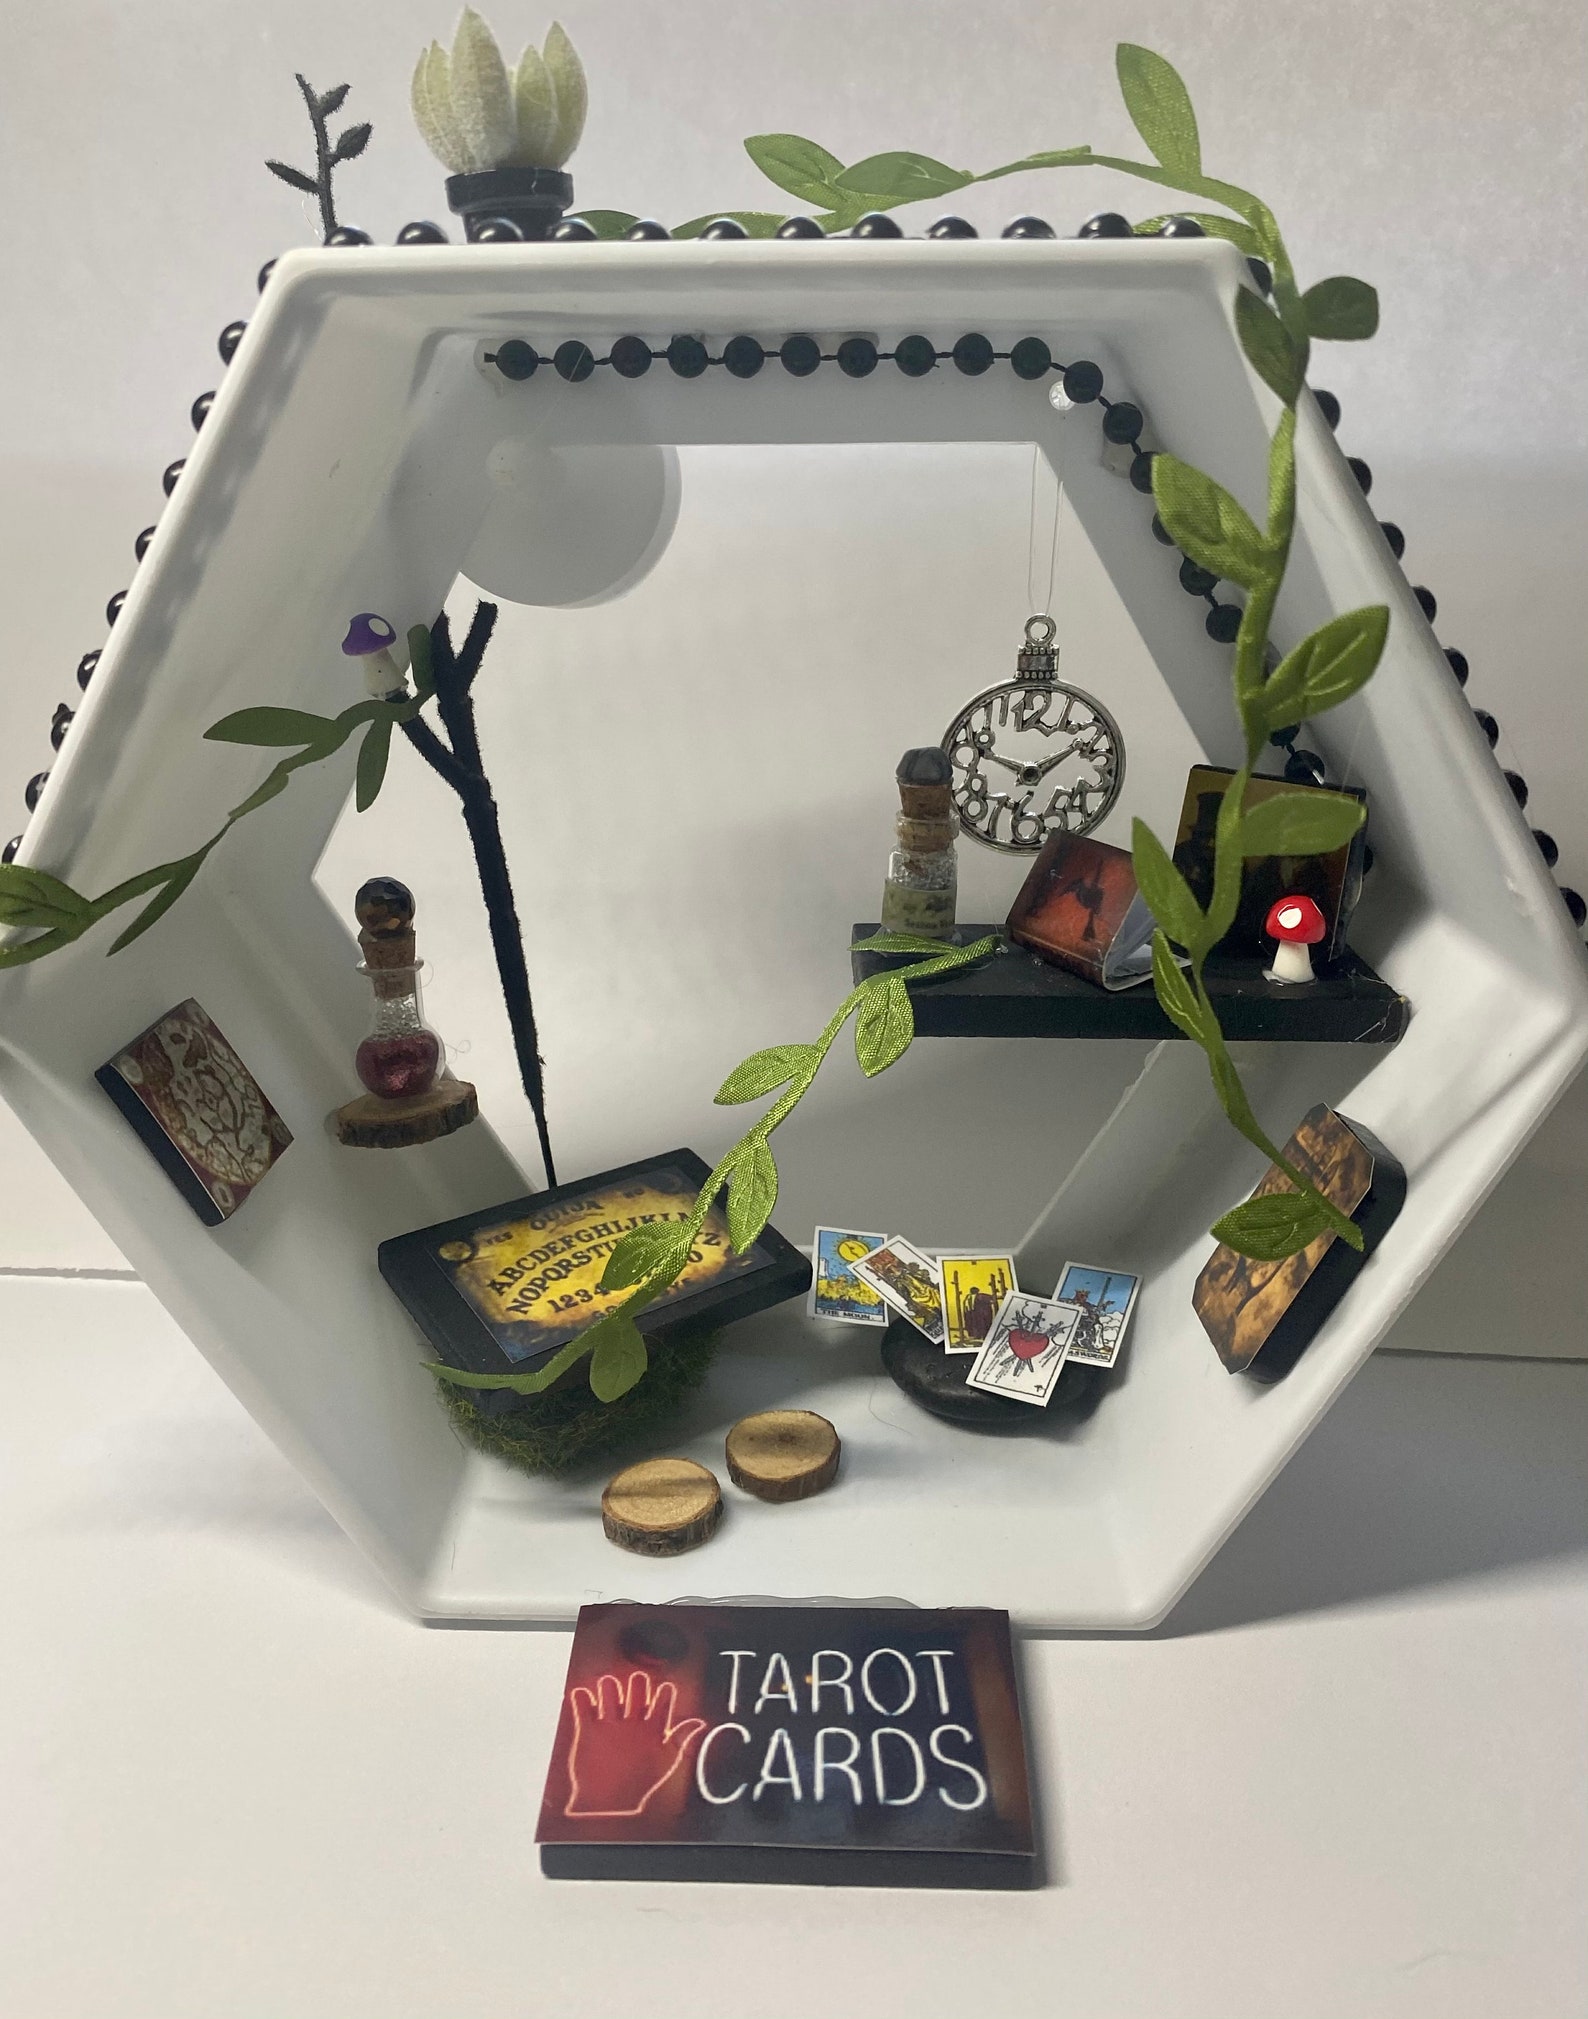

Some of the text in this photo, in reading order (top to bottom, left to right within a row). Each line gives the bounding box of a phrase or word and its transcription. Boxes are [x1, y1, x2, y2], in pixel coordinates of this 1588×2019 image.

[1011, 689, 1052, 733] 12
[961, 773, 989, 824] 8
[983, 793, 1010, 839] 7
[1011, 790, 1044, 844] 6
[1043, 786, 1070, 837] 5
[1065, 777, 1090, 825] 4
[719, 1647, 955, 1716] TAROT
[696, 1722, 989, 1811] CARDS
